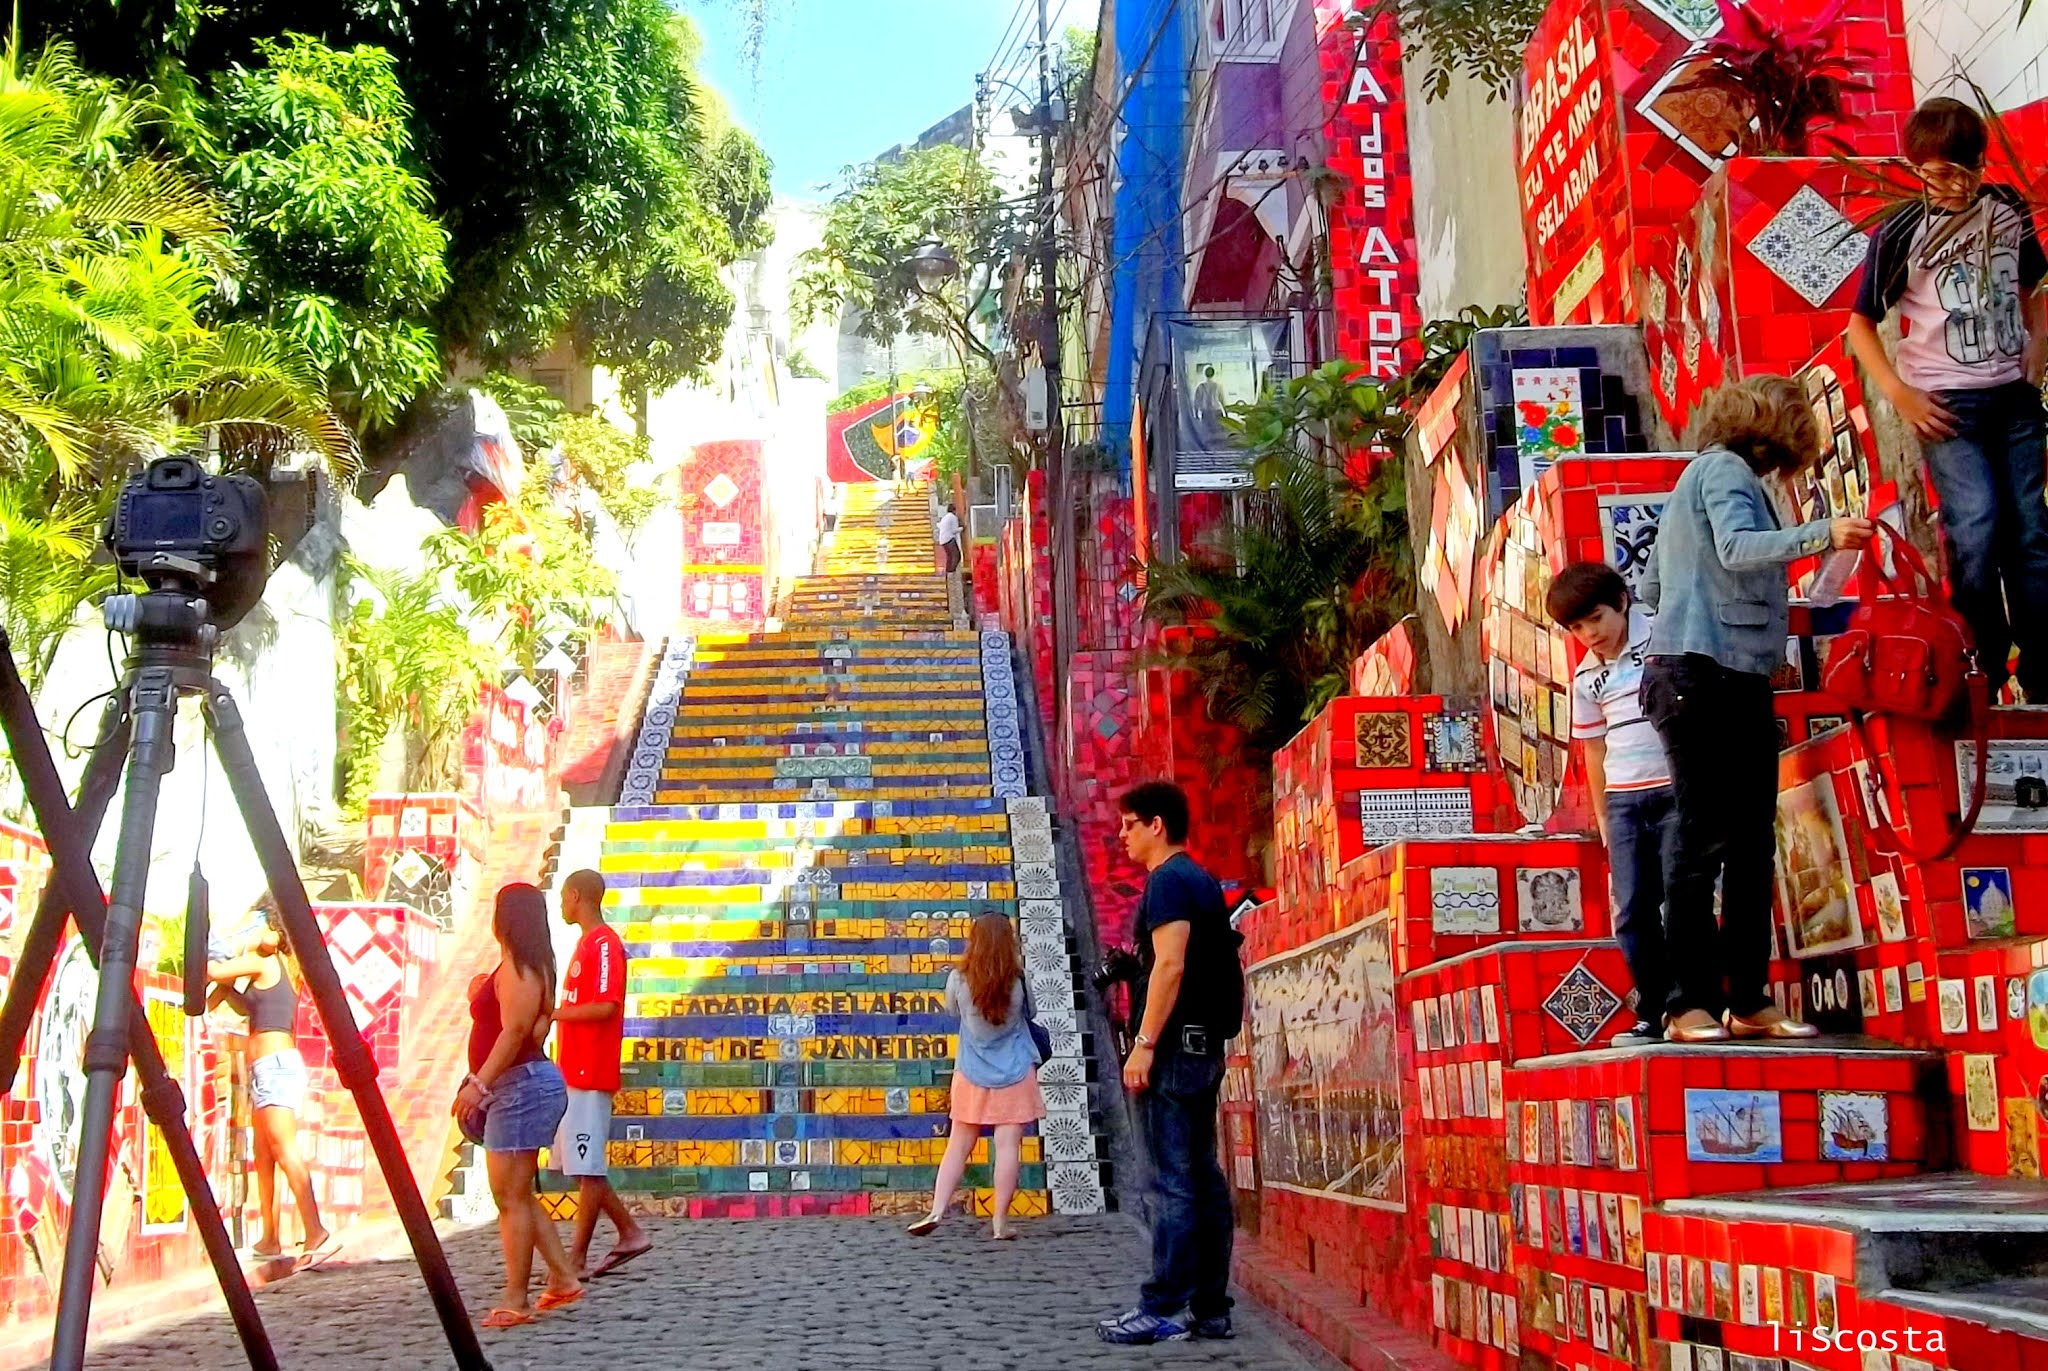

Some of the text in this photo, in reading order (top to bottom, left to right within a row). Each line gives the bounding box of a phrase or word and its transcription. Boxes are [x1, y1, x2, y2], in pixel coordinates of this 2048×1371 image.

[1543, 130, 1567, 174] TE
[1568, 78, 1601, 149] AMO
[1360, 227, 1402, 453] ATOR
[637, 997, 793, 1016] ESCADARIA
[633, 1038, 945, 1061] RIO DE JANEIRO
